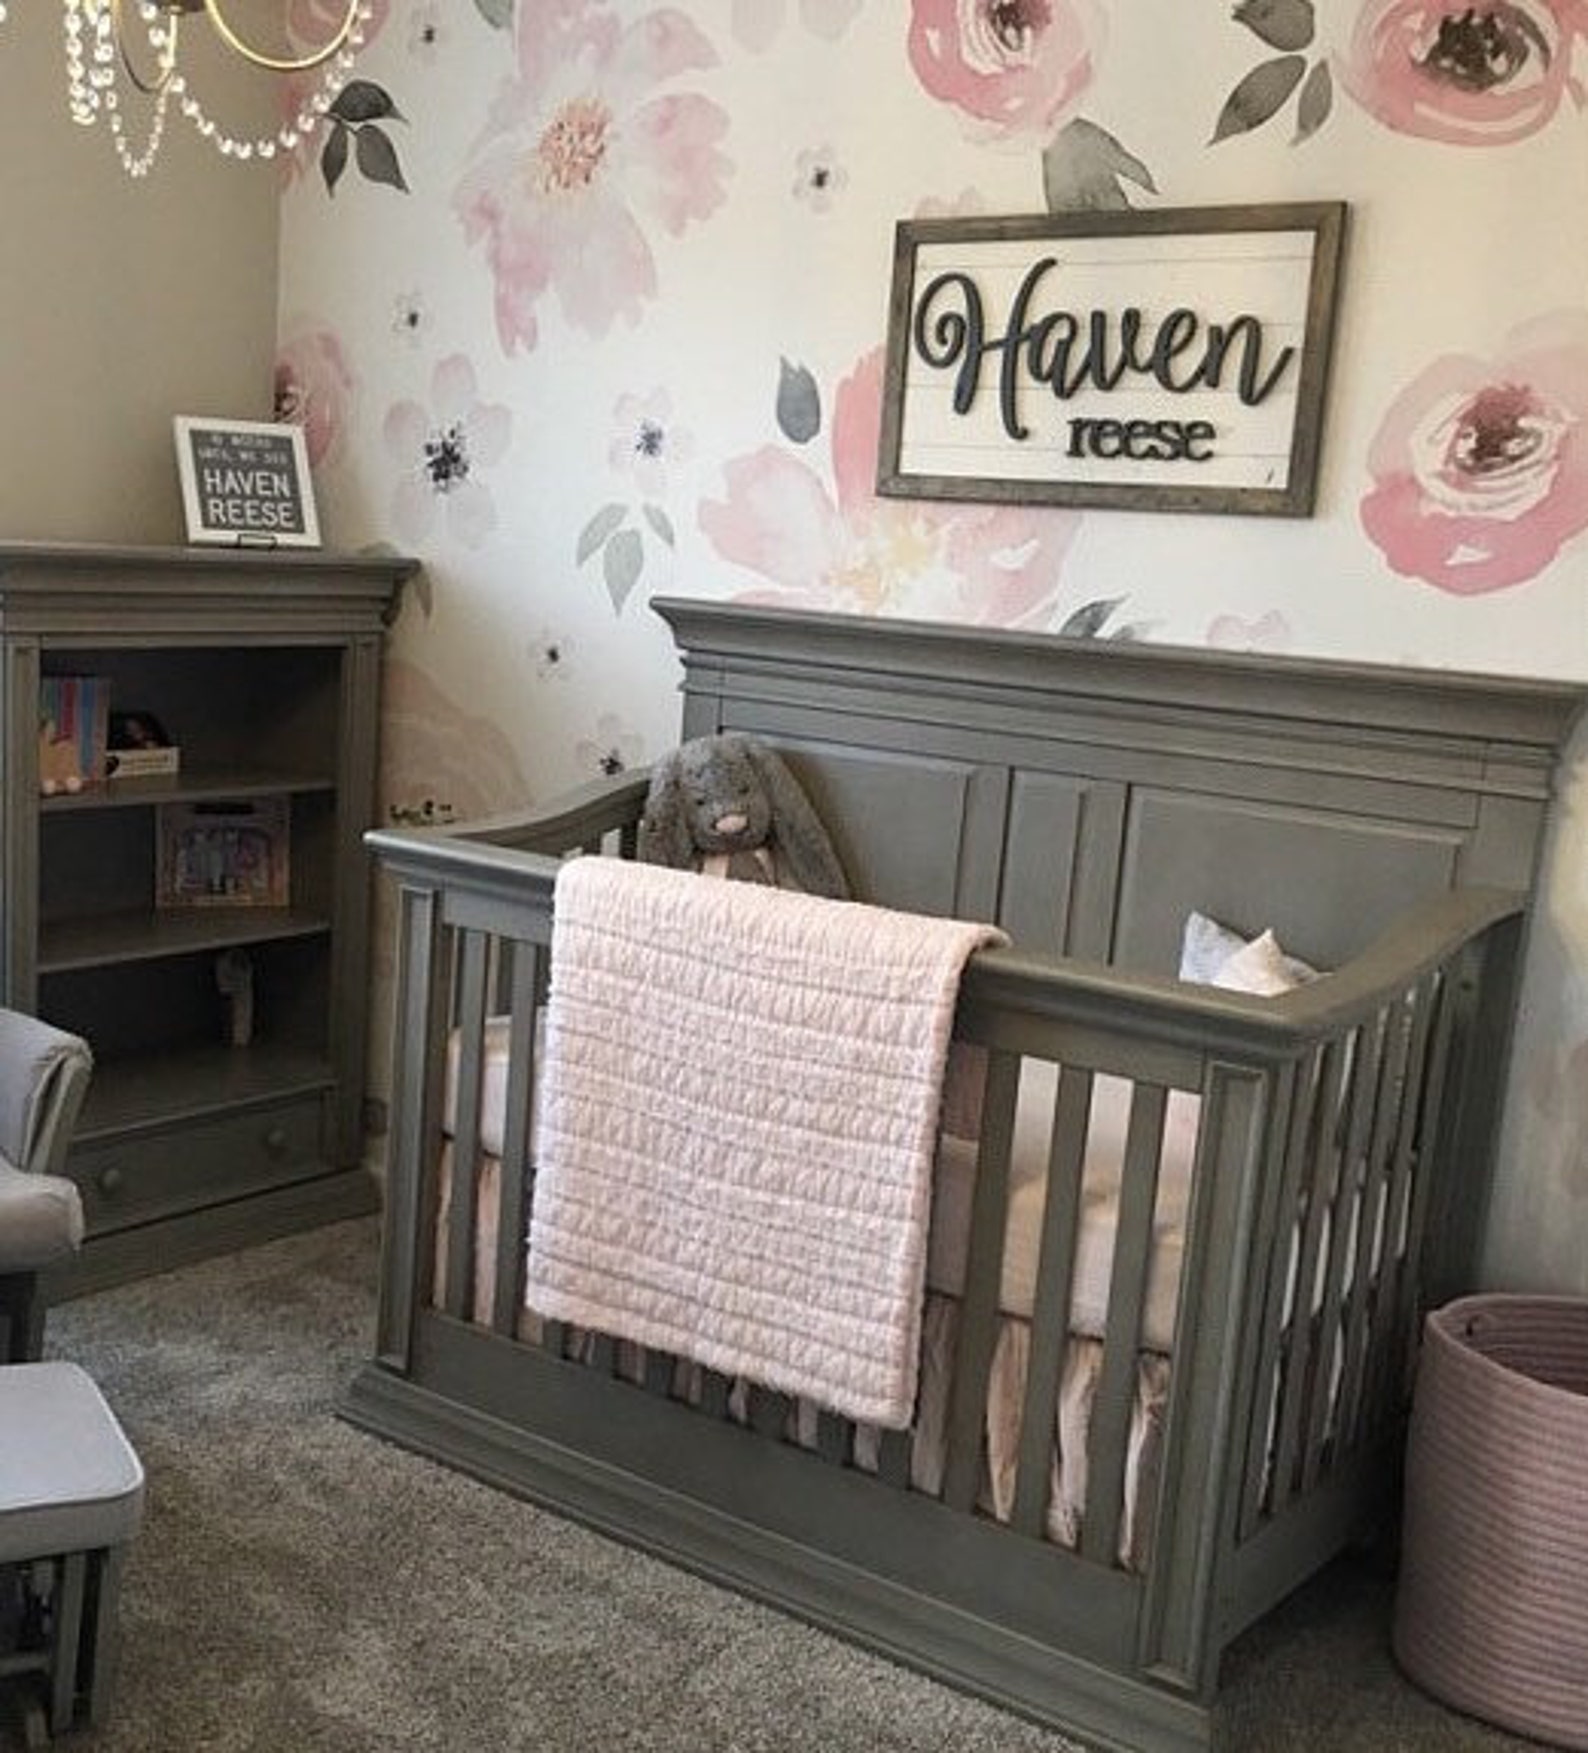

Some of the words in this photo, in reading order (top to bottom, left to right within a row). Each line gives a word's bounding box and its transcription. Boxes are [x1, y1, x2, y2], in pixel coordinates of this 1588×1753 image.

[915, 258, 1294, 440] Haven
[1065, 416, 1216, 461] reese
[204, 468, 291, 498] HAVEN
[208, 498, 295, 528] REESE
